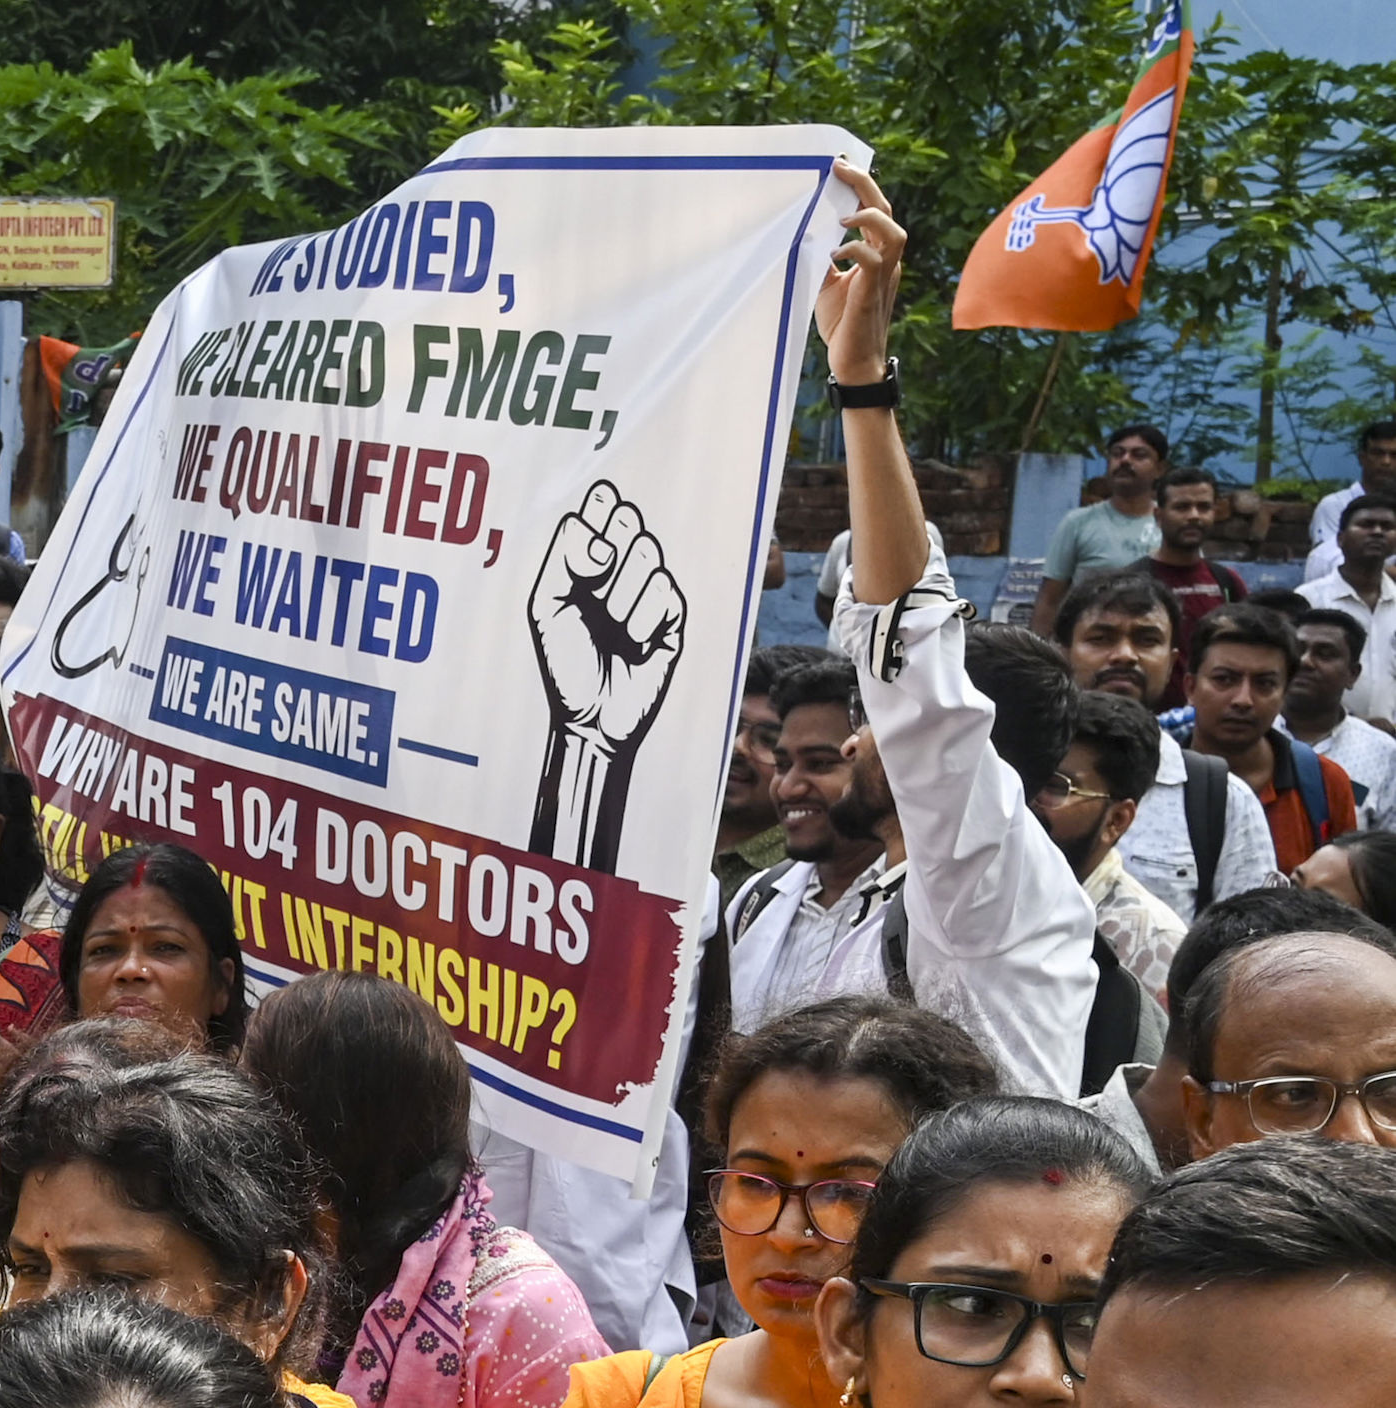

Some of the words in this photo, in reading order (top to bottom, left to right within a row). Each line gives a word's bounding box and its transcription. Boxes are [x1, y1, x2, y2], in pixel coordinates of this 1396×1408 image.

[294, 200, 516, 314] STUDIED,
[175, 327, 233, 397] WE
[209, 319, 386, 408] CLEARED
[406, 324, 620, 451] FMGE,
[173, 424, 221, 504] WE
[220, 426, 504, 569] QUALIFIED,
[167, 530, 228, 617] WE
[235, 541, 440, 664] WAITED
[161, 653, 205, 716] WE
[204, 666, 265, 735] ARE
[271, 682, 379, 767] SAME.
[37, 715, 122, 803] WHY
[110, 749, 197, 836] ARE
[212, 780, 299, 870] 104
[315, 807, 595, 965] DOCTORS
